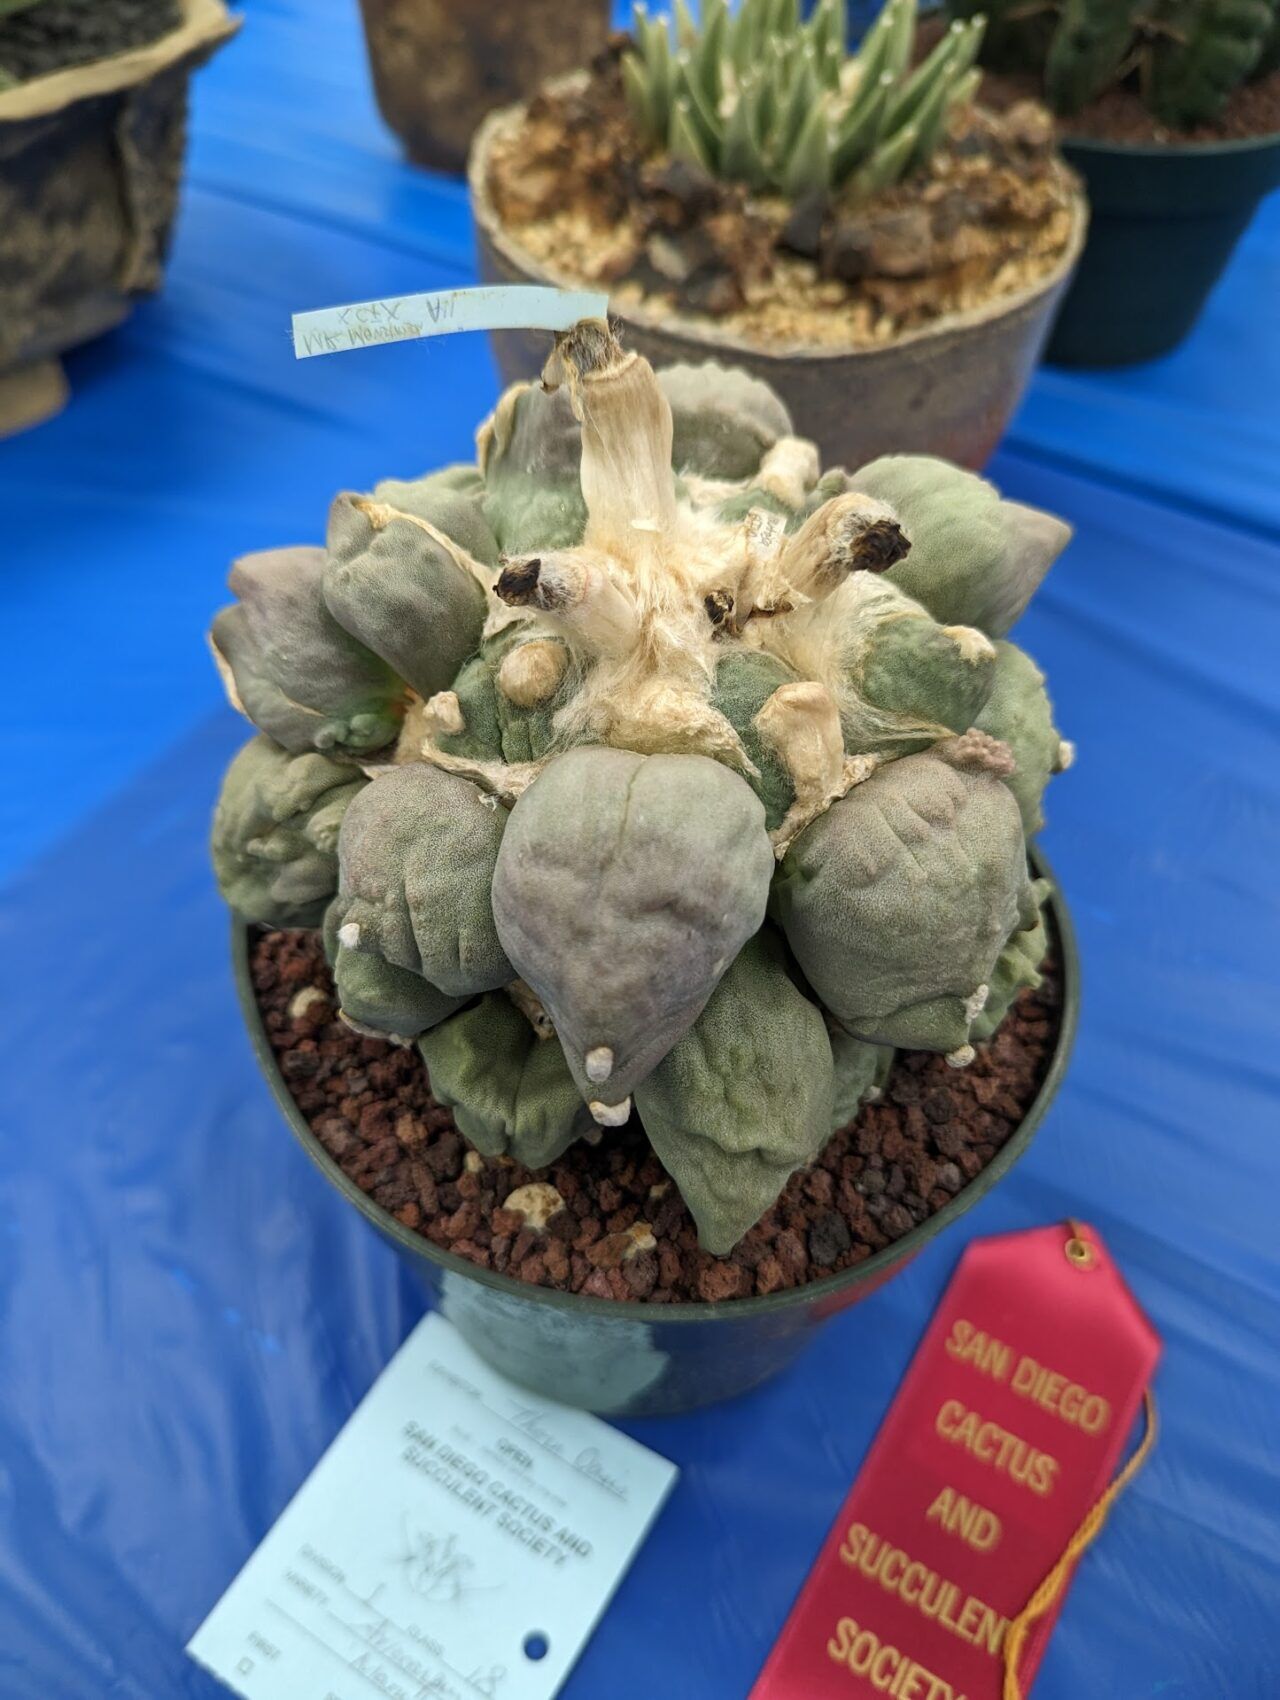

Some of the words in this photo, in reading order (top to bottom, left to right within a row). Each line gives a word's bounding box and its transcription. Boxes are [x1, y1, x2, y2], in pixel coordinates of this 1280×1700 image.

[945, 1319, 1014, 1382] SAN
[1010, 1356, 1110, 1434] DIEGO
[403, 1420, 437, 1451] SAN
[436, 1444, 489, 1487] DIEGO
[487, 1479, 557, 1533] CACTUS
[554, 1526, 595, 1559] AND
[935, 1400, 1060, 1495] CACTUS
[402, 1444, 499, 1517] SUCCULENT
[496, 1510, 568, 1567] SOCIETY
[926, 1486, 1001, 1552] AND
[827, 1616, 968, 1700] SOCIET
